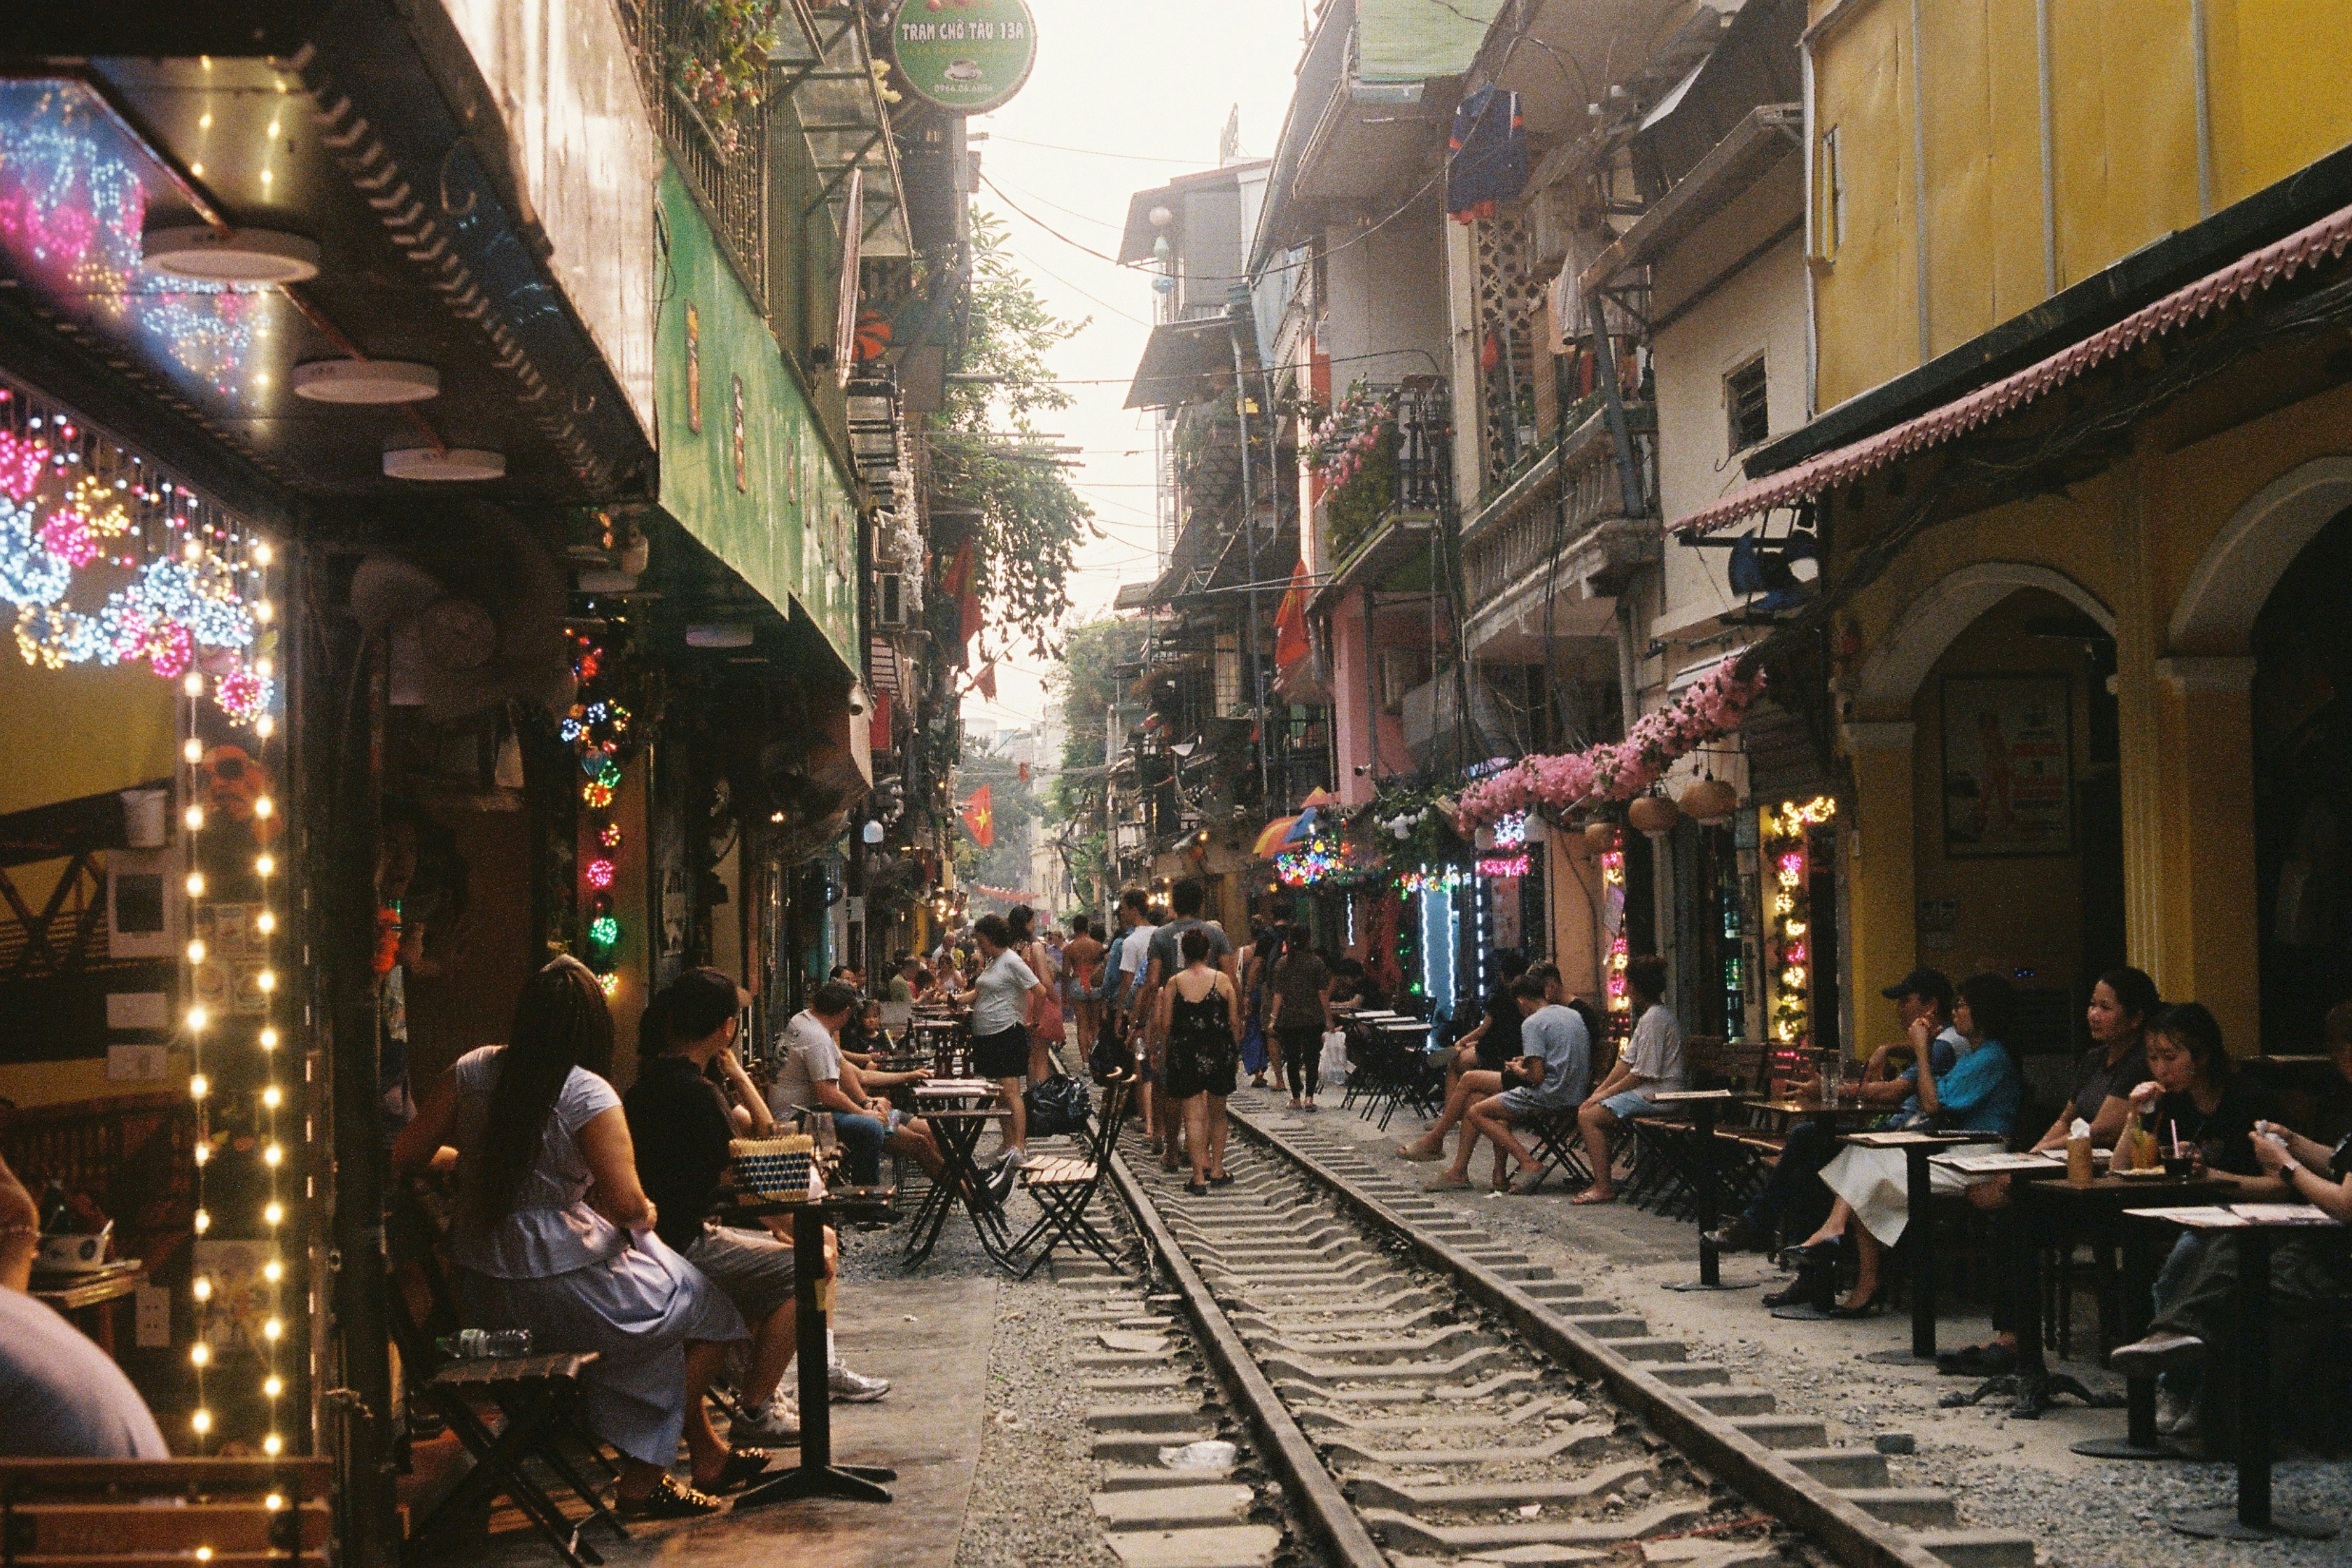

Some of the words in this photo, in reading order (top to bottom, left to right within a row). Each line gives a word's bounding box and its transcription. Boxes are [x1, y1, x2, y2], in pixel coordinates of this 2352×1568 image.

[902, 23, 935, 43] TRẠM
[969, 19, 993, 39] TÀU
[1000, 22, 1024, 40] 13A
